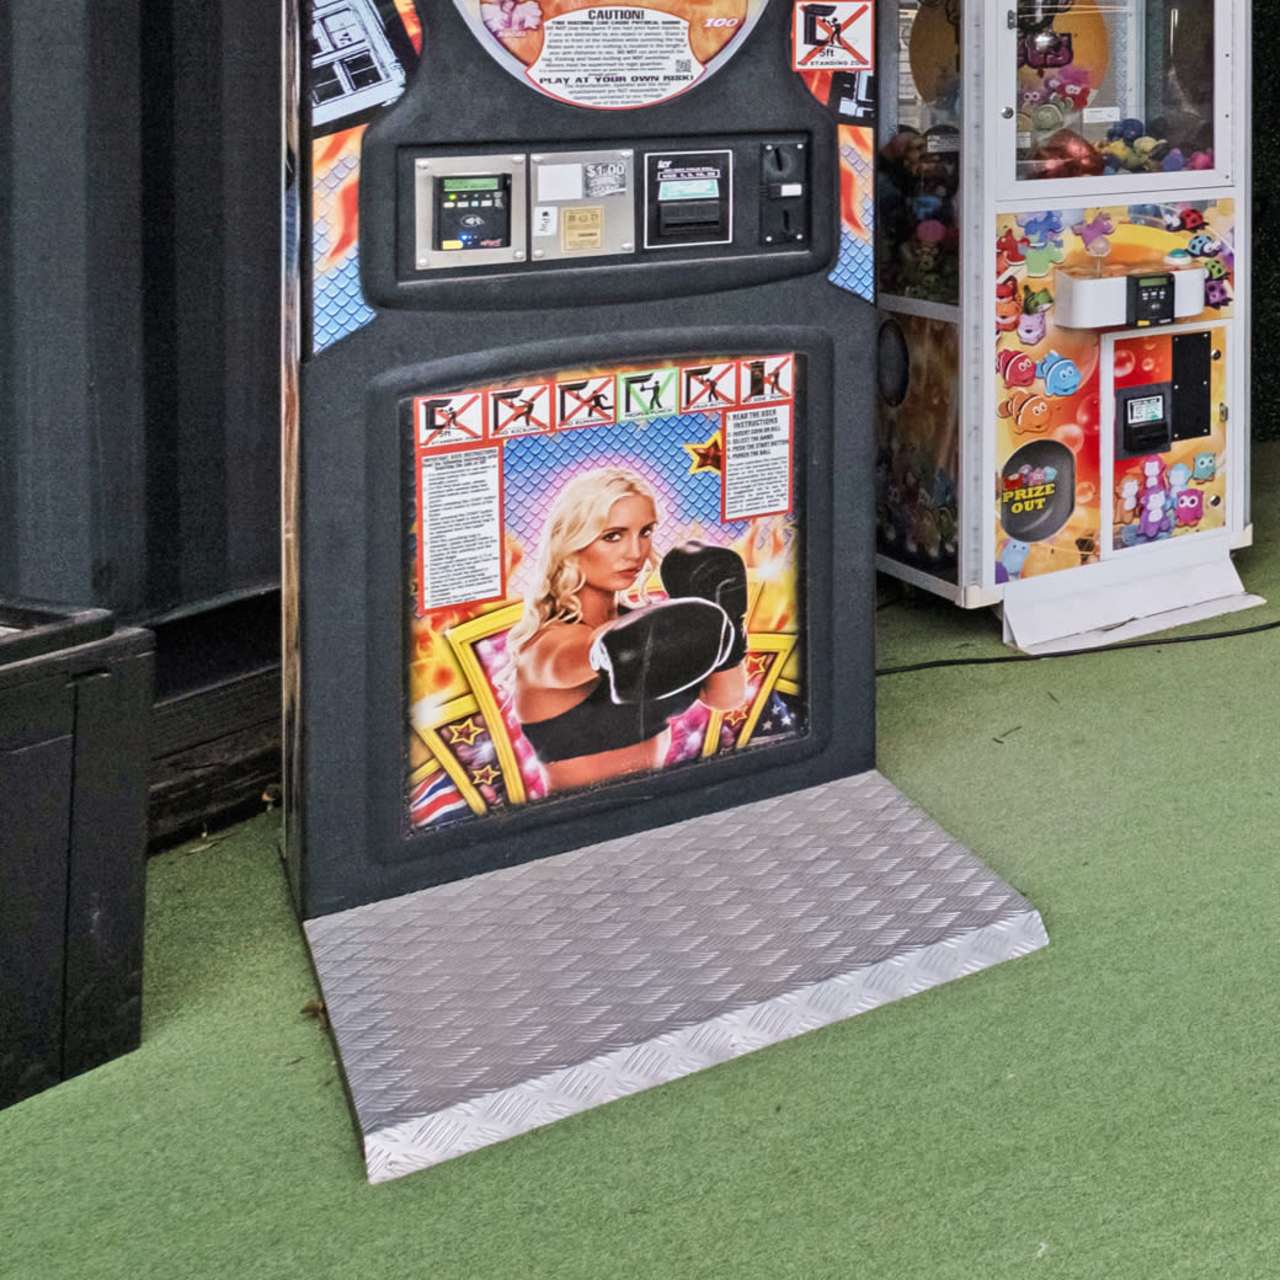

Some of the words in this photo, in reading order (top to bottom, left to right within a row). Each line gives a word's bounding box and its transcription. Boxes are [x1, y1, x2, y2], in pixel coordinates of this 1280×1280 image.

[587, 9, 645, 20] CAUTION!
[703, 16, 740, 29] 100
[539, 77, 570, 85] PLAY
[586, 164, 625, 177] $1.00
[1002, 483, 1056, 503] PRIZE
[1011, 498, 1046, 514] OUT
